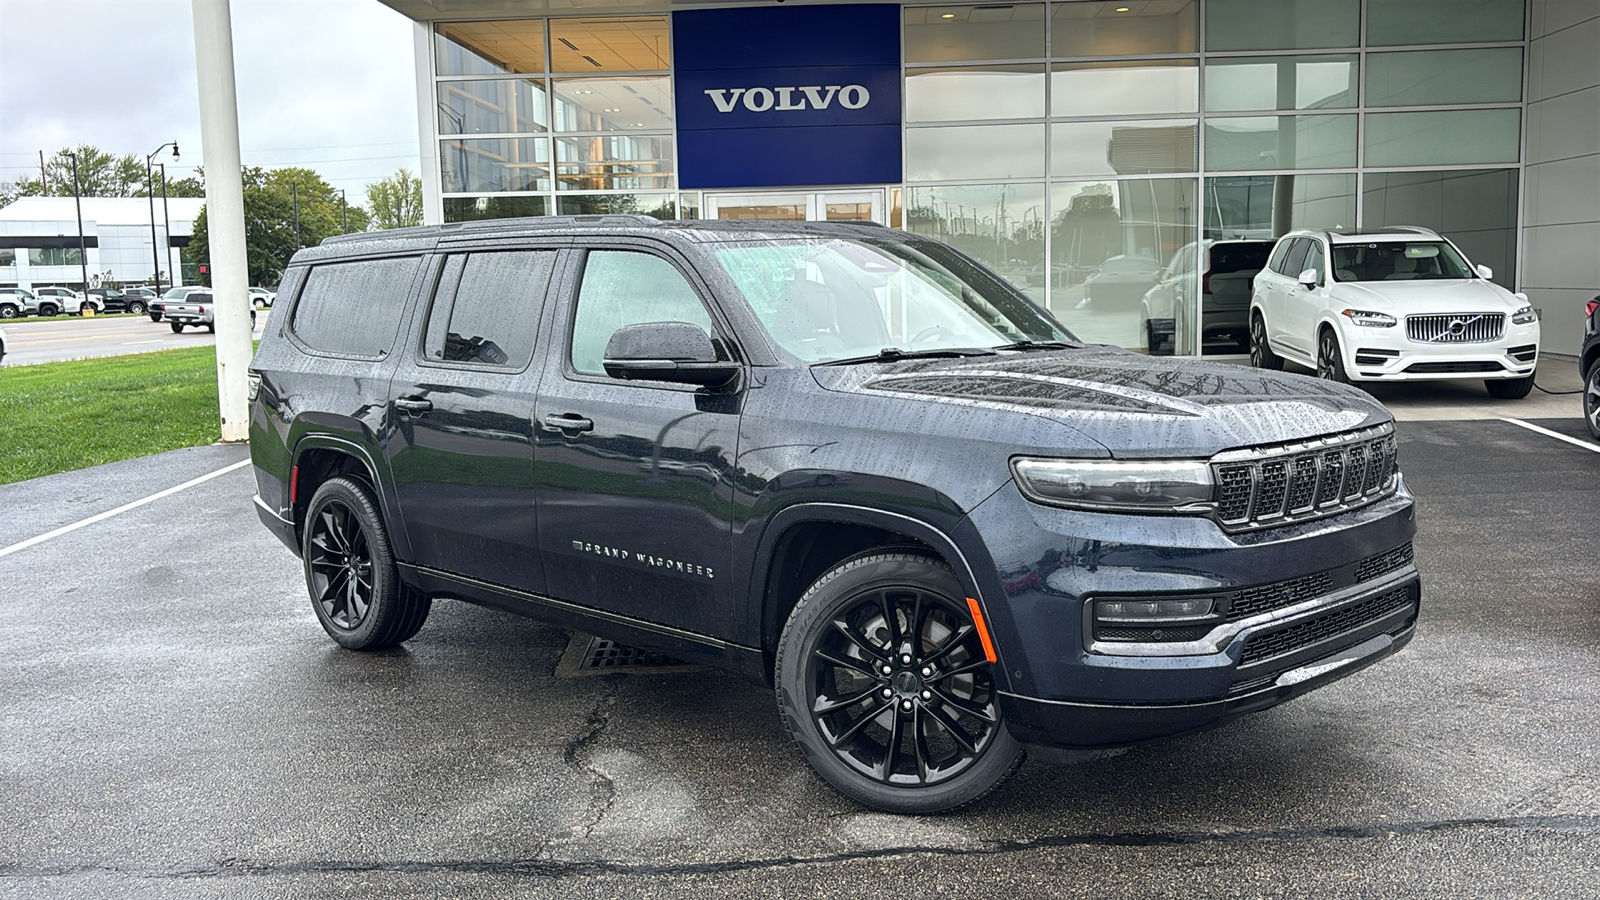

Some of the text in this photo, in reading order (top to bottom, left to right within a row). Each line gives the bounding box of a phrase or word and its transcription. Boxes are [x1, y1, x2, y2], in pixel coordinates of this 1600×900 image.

[704, 84, 870, 113] VOLVO
[585, 543, 714, 578] GRAND WAGONEER
